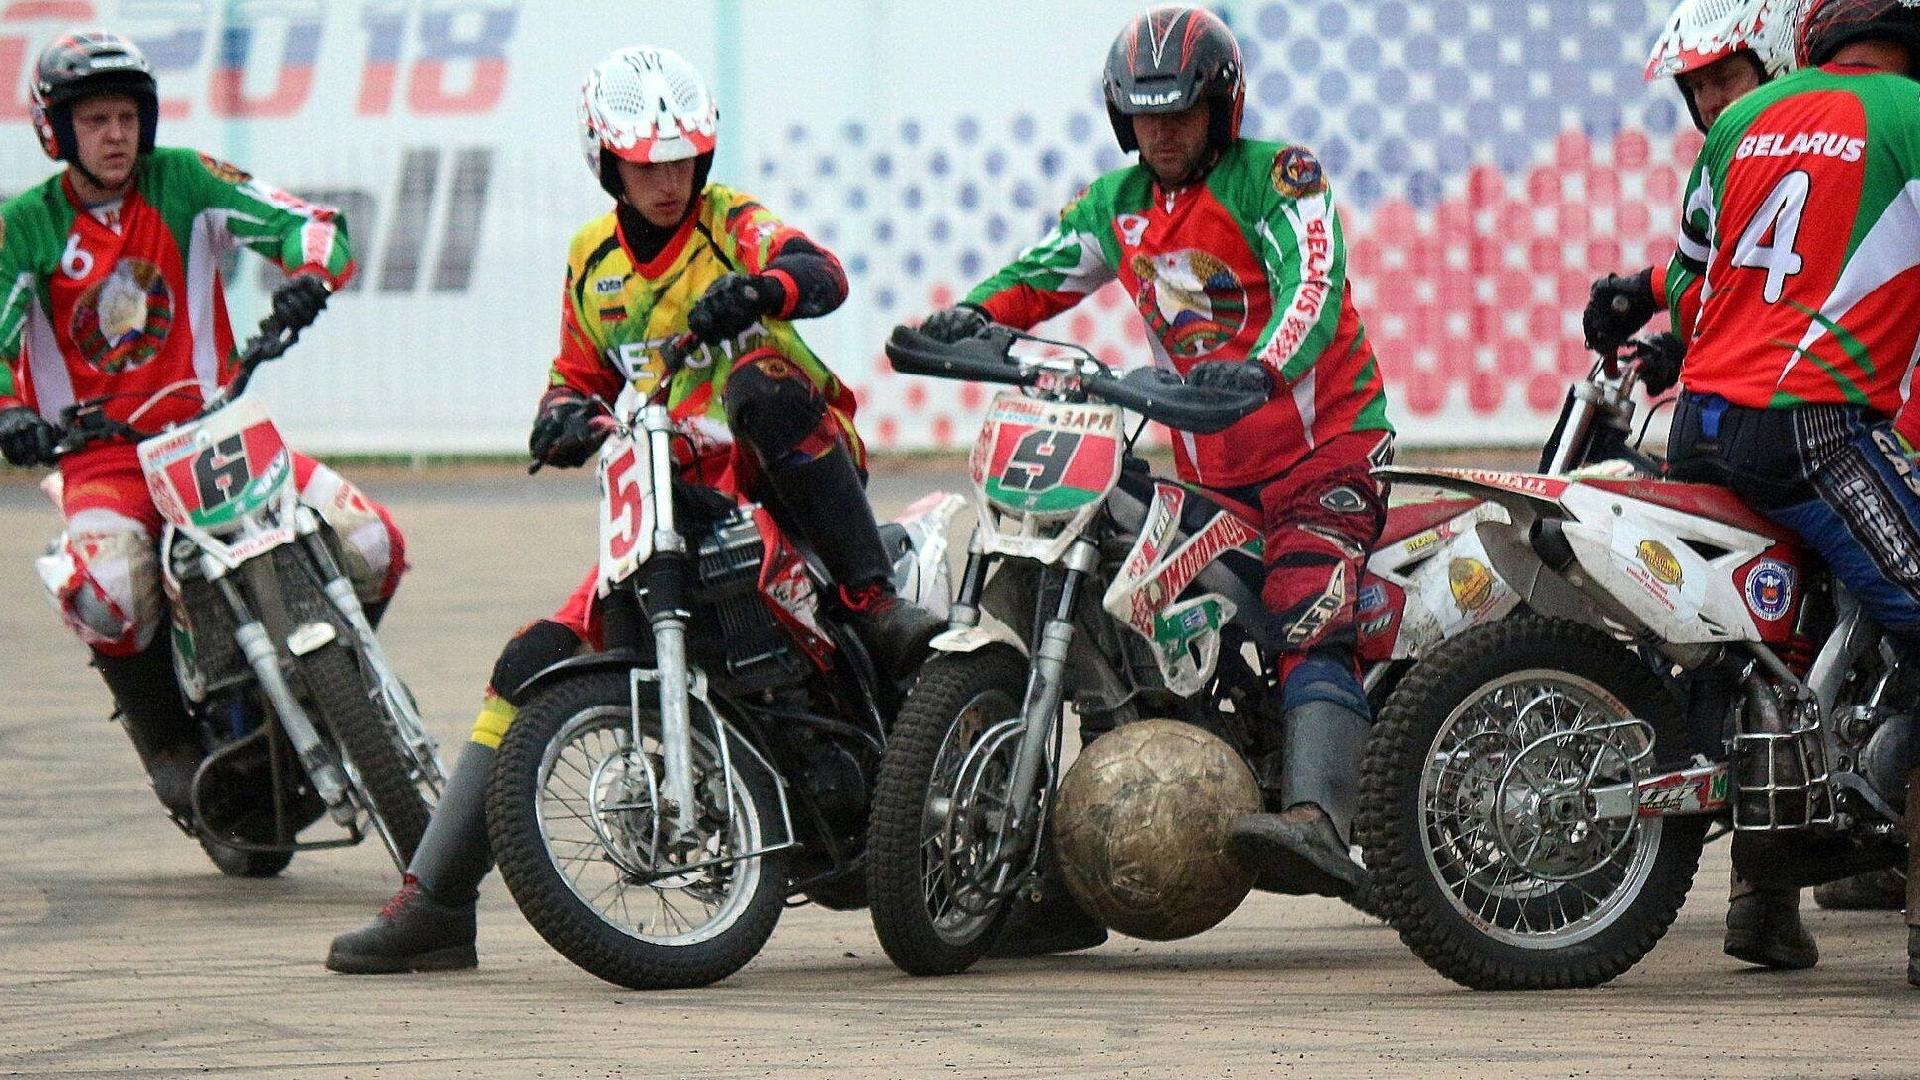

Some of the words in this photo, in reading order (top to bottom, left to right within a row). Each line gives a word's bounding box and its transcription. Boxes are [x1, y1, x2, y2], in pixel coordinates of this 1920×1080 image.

[1736, 130, 1866, 163] BELARUS
[61, 239, 93, 281] 6
[1731, 170, 1811, 305] 4
[195, 432, 250, 512] 6
[1001, 430, 1081, 493] 9
[606, 447, 643, 560] 5
